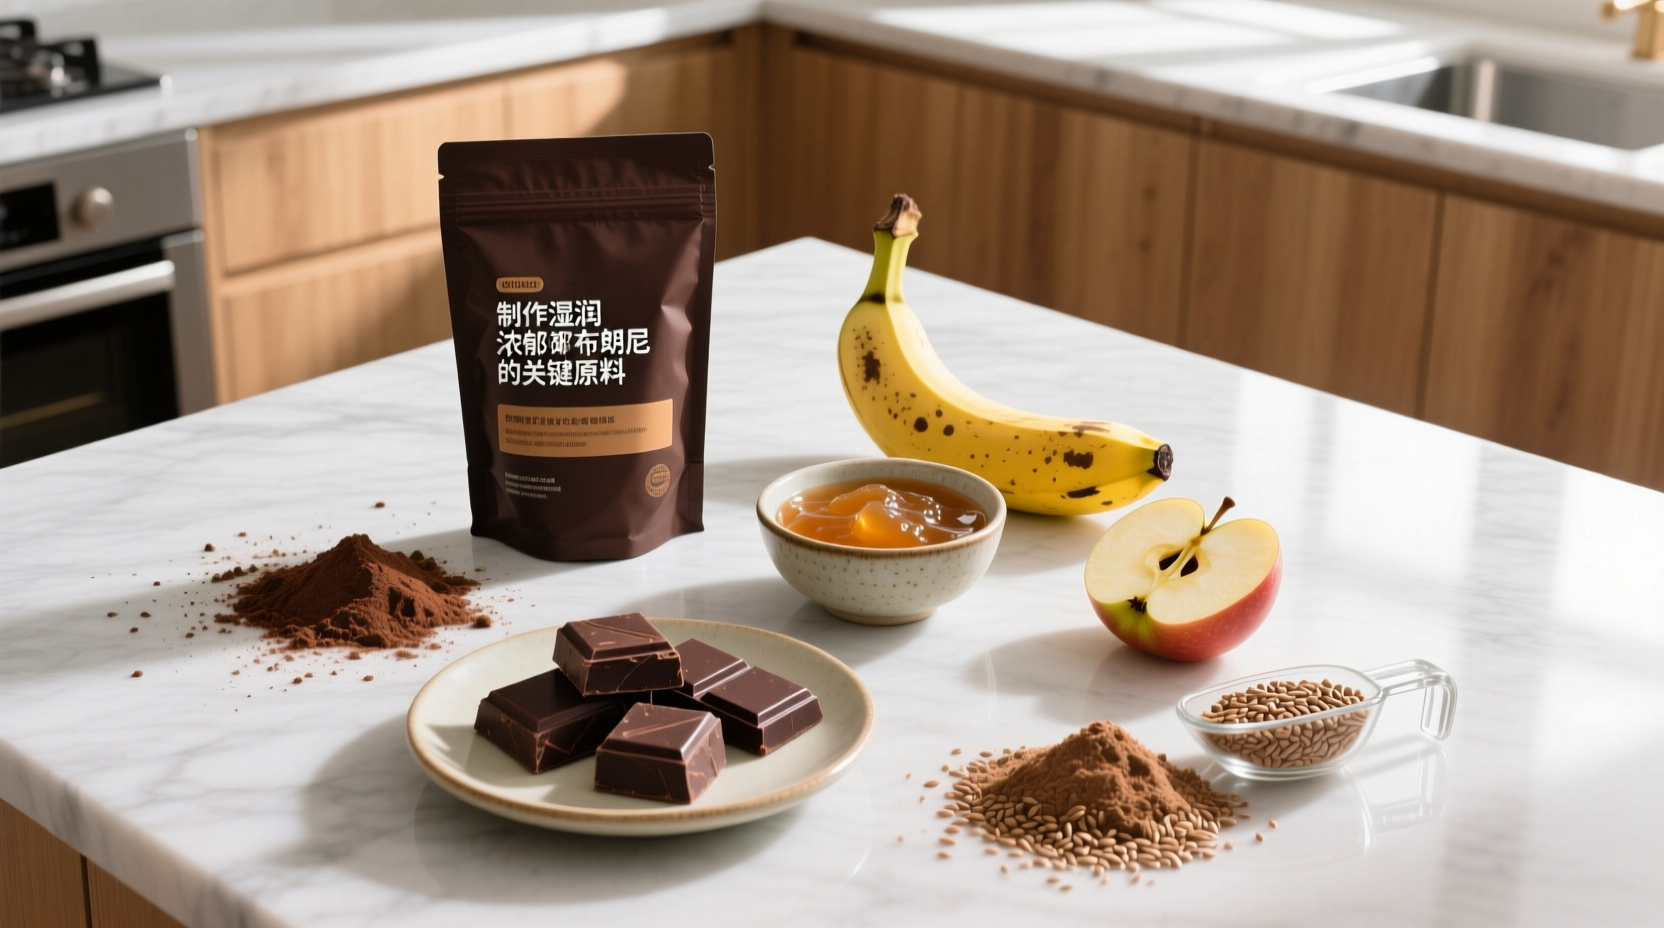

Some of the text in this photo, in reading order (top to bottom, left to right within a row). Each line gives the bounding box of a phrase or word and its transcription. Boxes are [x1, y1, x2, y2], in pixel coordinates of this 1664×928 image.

[496, 299, 602, 328] 制作湿润
[497, 357, 626, 386] 的关键原料
